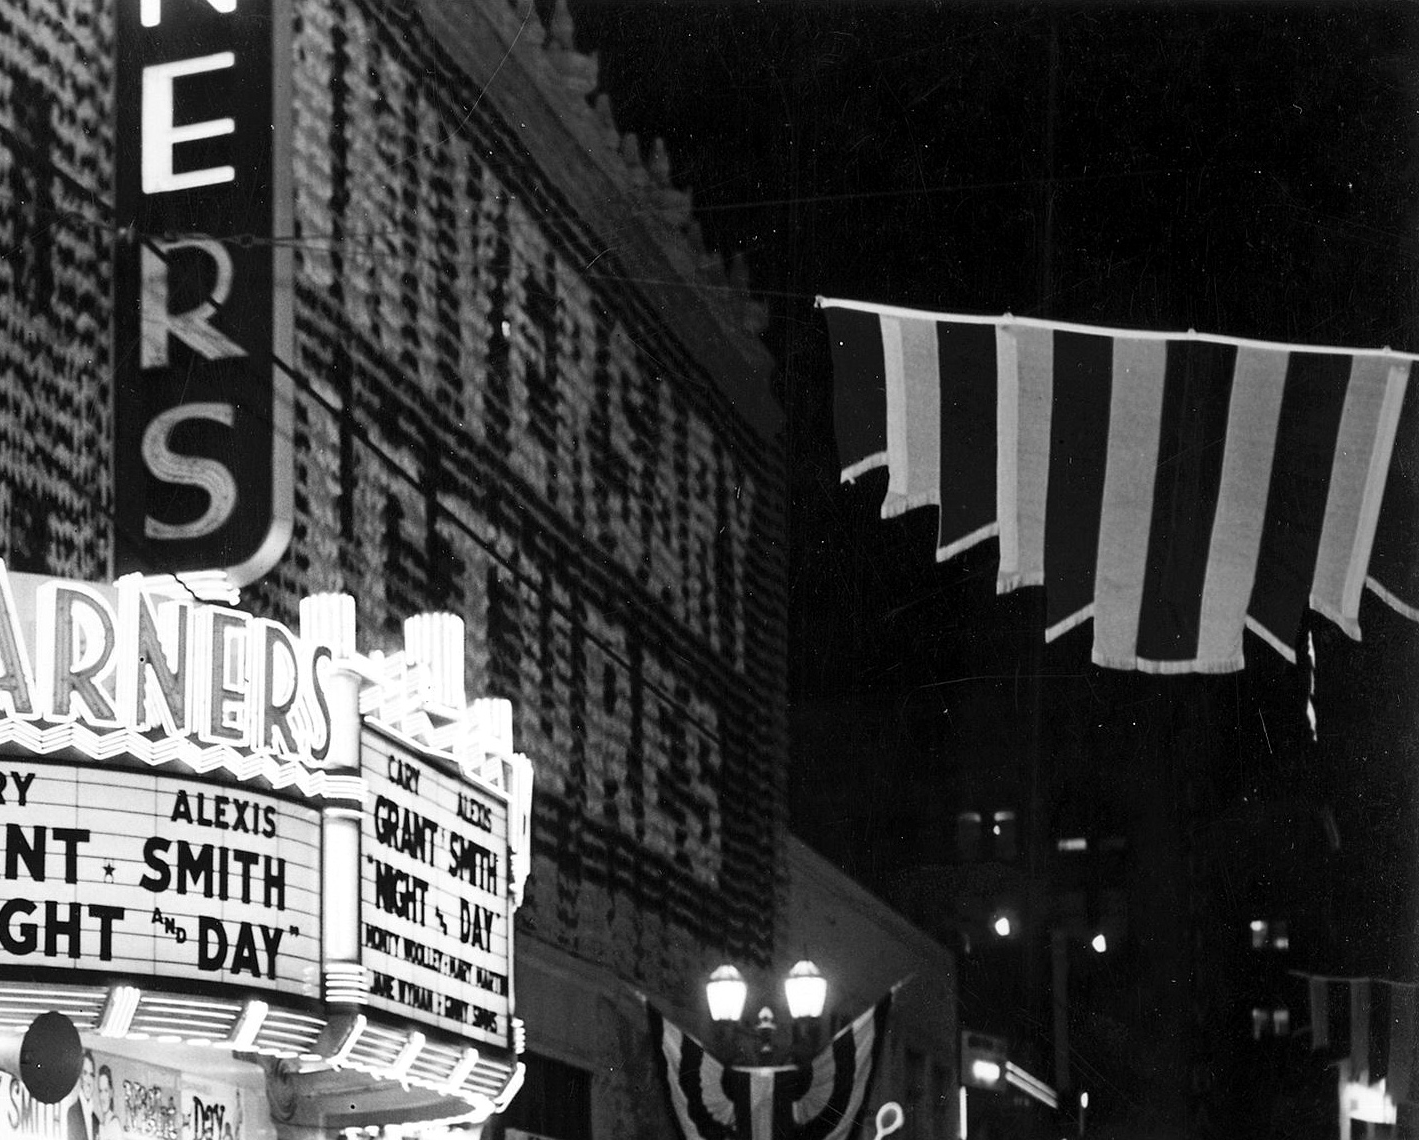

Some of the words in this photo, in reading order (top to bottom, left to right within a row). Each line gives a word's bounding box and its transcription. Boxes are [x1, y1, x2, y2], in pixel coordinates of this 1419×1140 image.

[139, 0, 249, 540] ERS
[387, 754, 420, 797] CARY
[171, 790, 278, 839] ALEXIS
[373, 794, 439, 868] GRANT
[448, 830, 499, 897] SMITH
[138, 837, 286, 912] SMITH
[151, 907, 188, 945] AND
